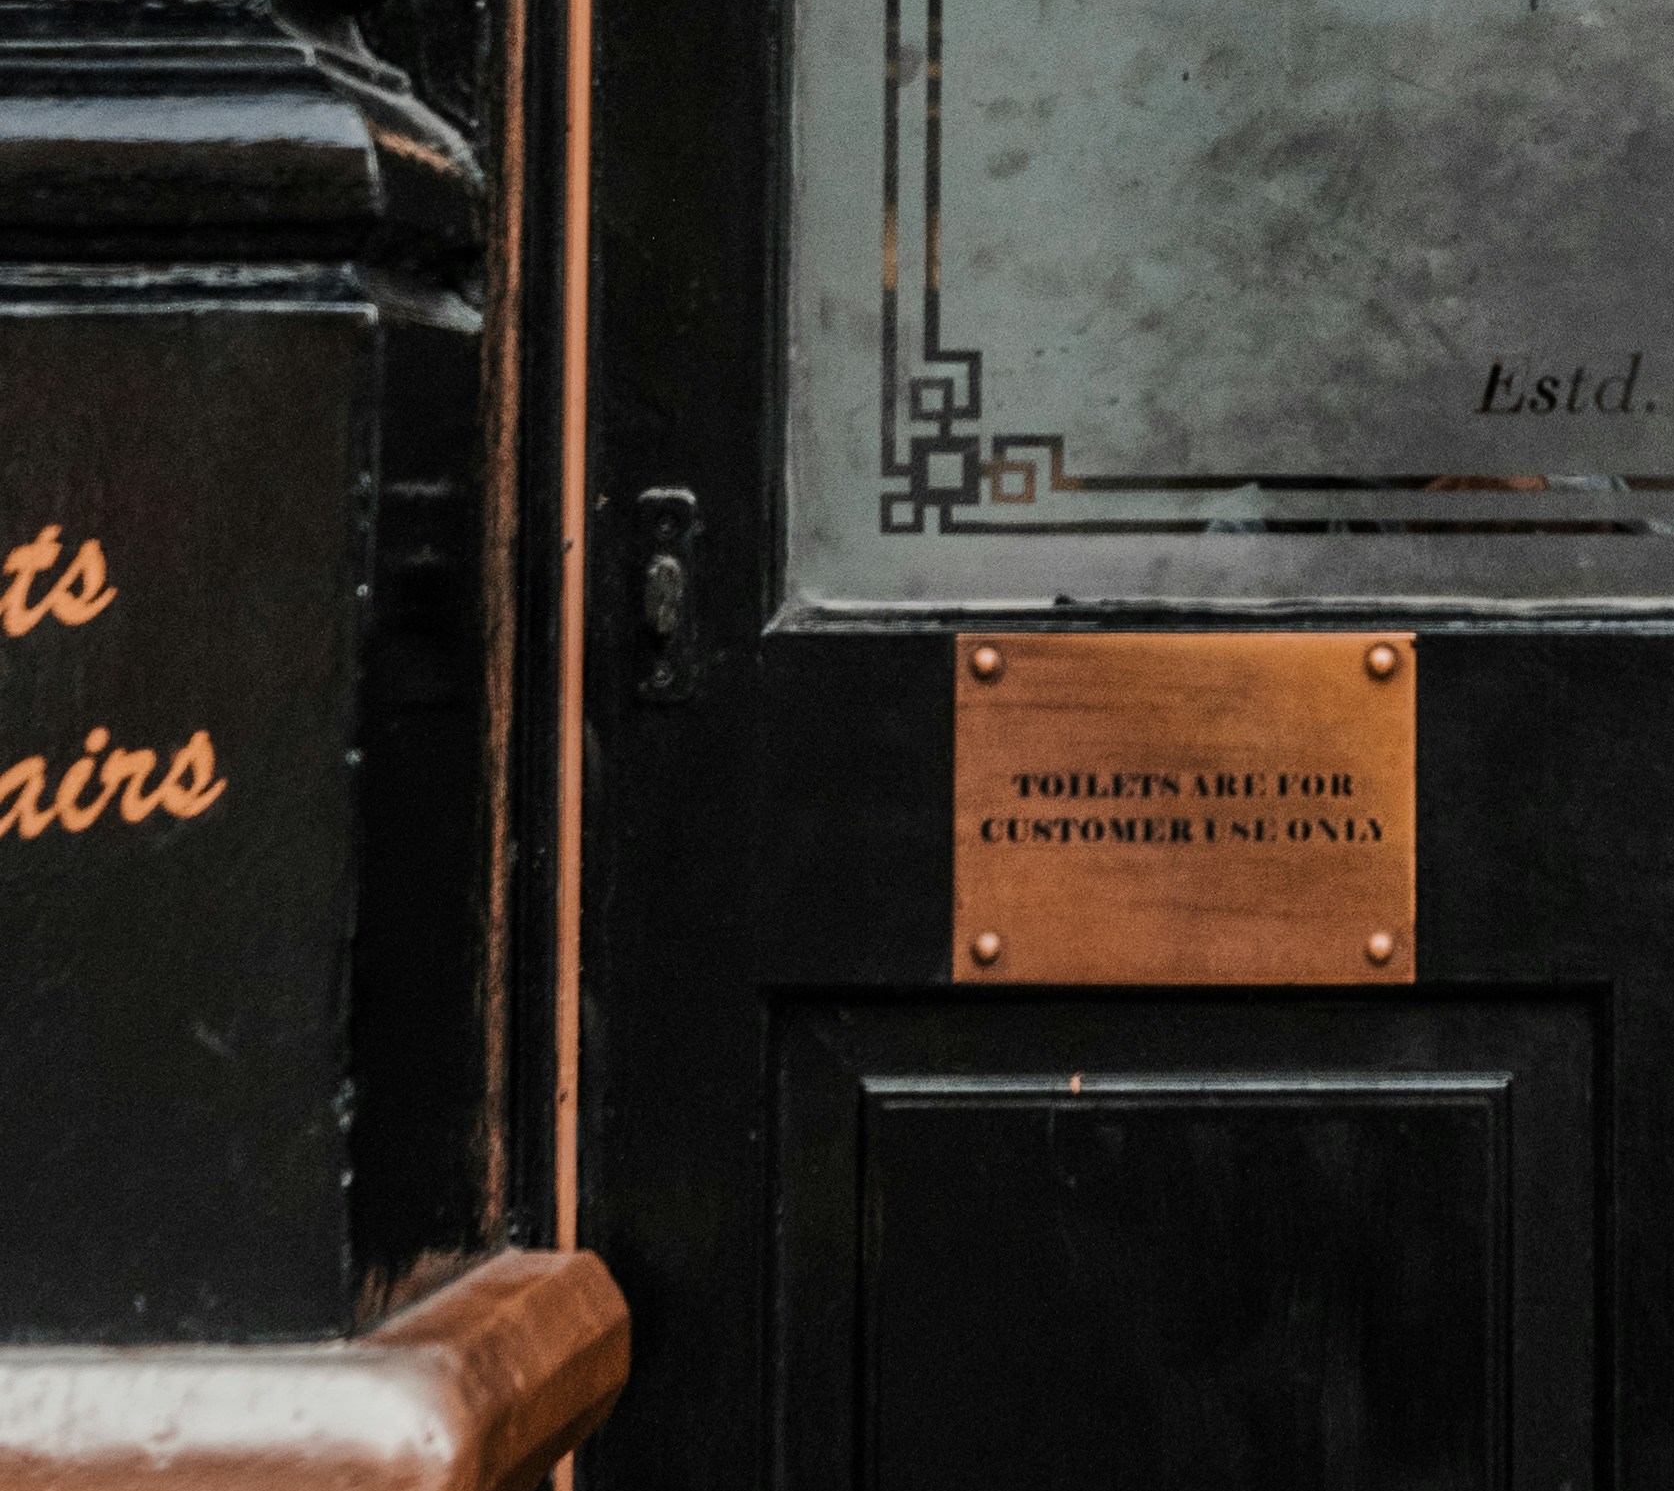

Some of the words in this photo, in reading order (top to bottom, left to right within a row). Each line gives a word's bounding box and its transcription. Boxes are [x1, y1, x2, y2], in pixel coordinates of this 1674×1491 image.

[1473, 352, 1657, 414] Estd.
[1011, 772, 1181, 799] TOILETS
[1192, 772, 1268, 799] ARE
[1278, 772, 1356, 799] FOR
[979, 817, 1195, 844] CUSTOMER
[1204, 817, 1278, 844] USE
[1286, 817, 1384, 844] ONLY
